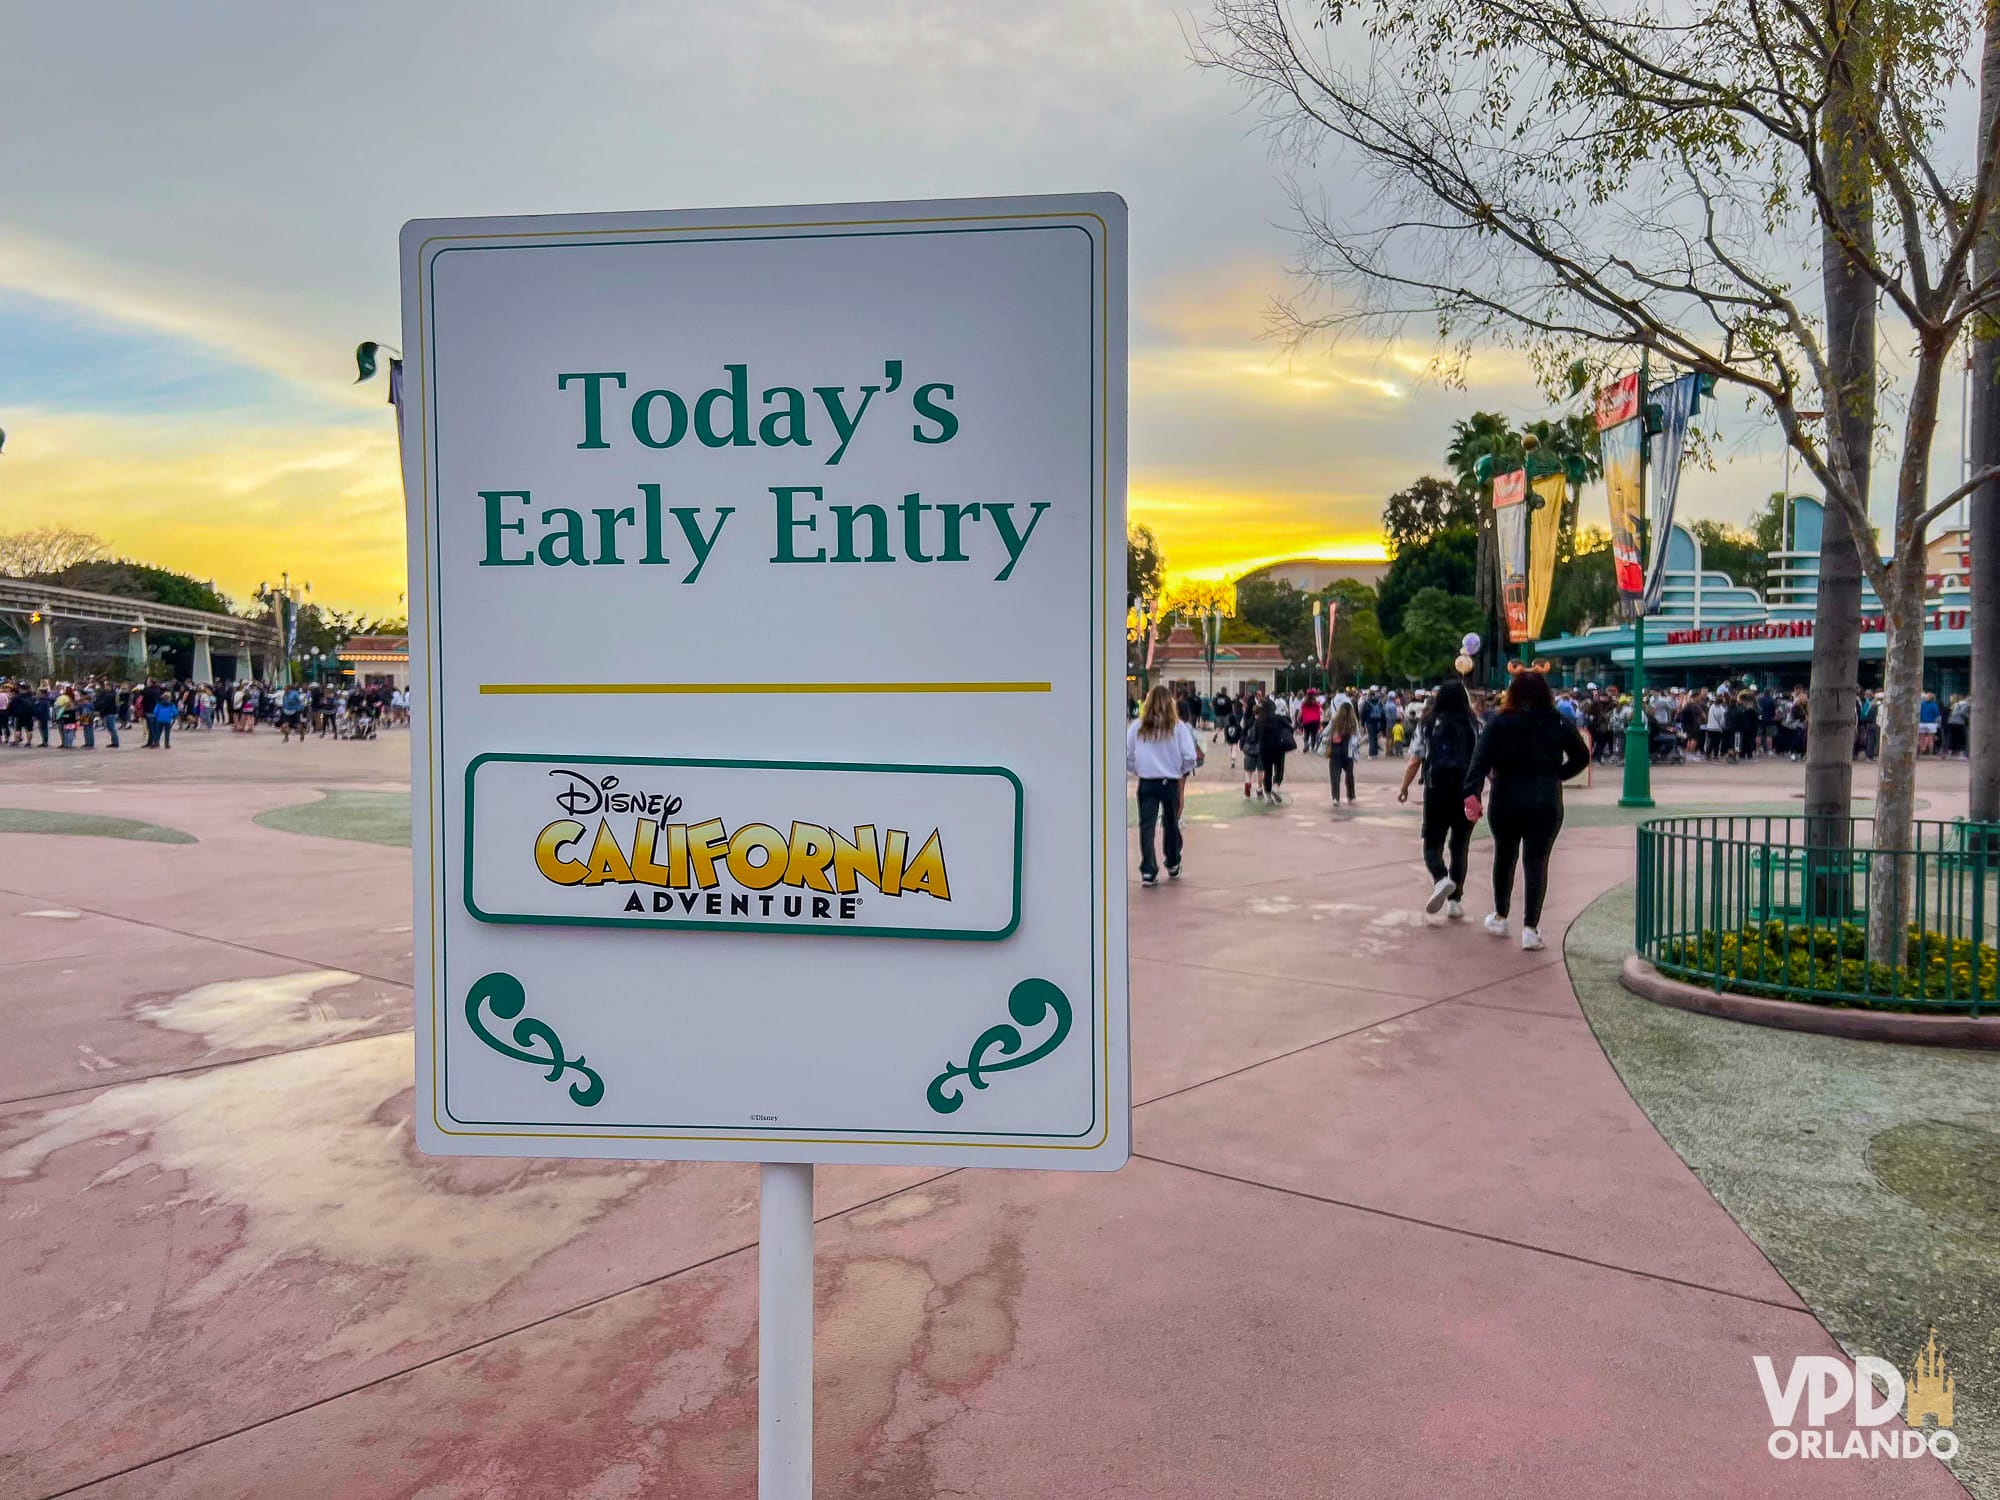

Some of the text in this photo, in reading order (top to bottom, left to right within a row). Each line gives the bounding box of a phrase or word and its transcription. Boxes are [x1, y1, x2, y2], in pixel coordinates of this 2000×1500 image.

[557, 359, 960, 466] Today's
[477, 483, 1052, 585] Early Entry
[534, 815, 951, 902] CALIFORNIA
